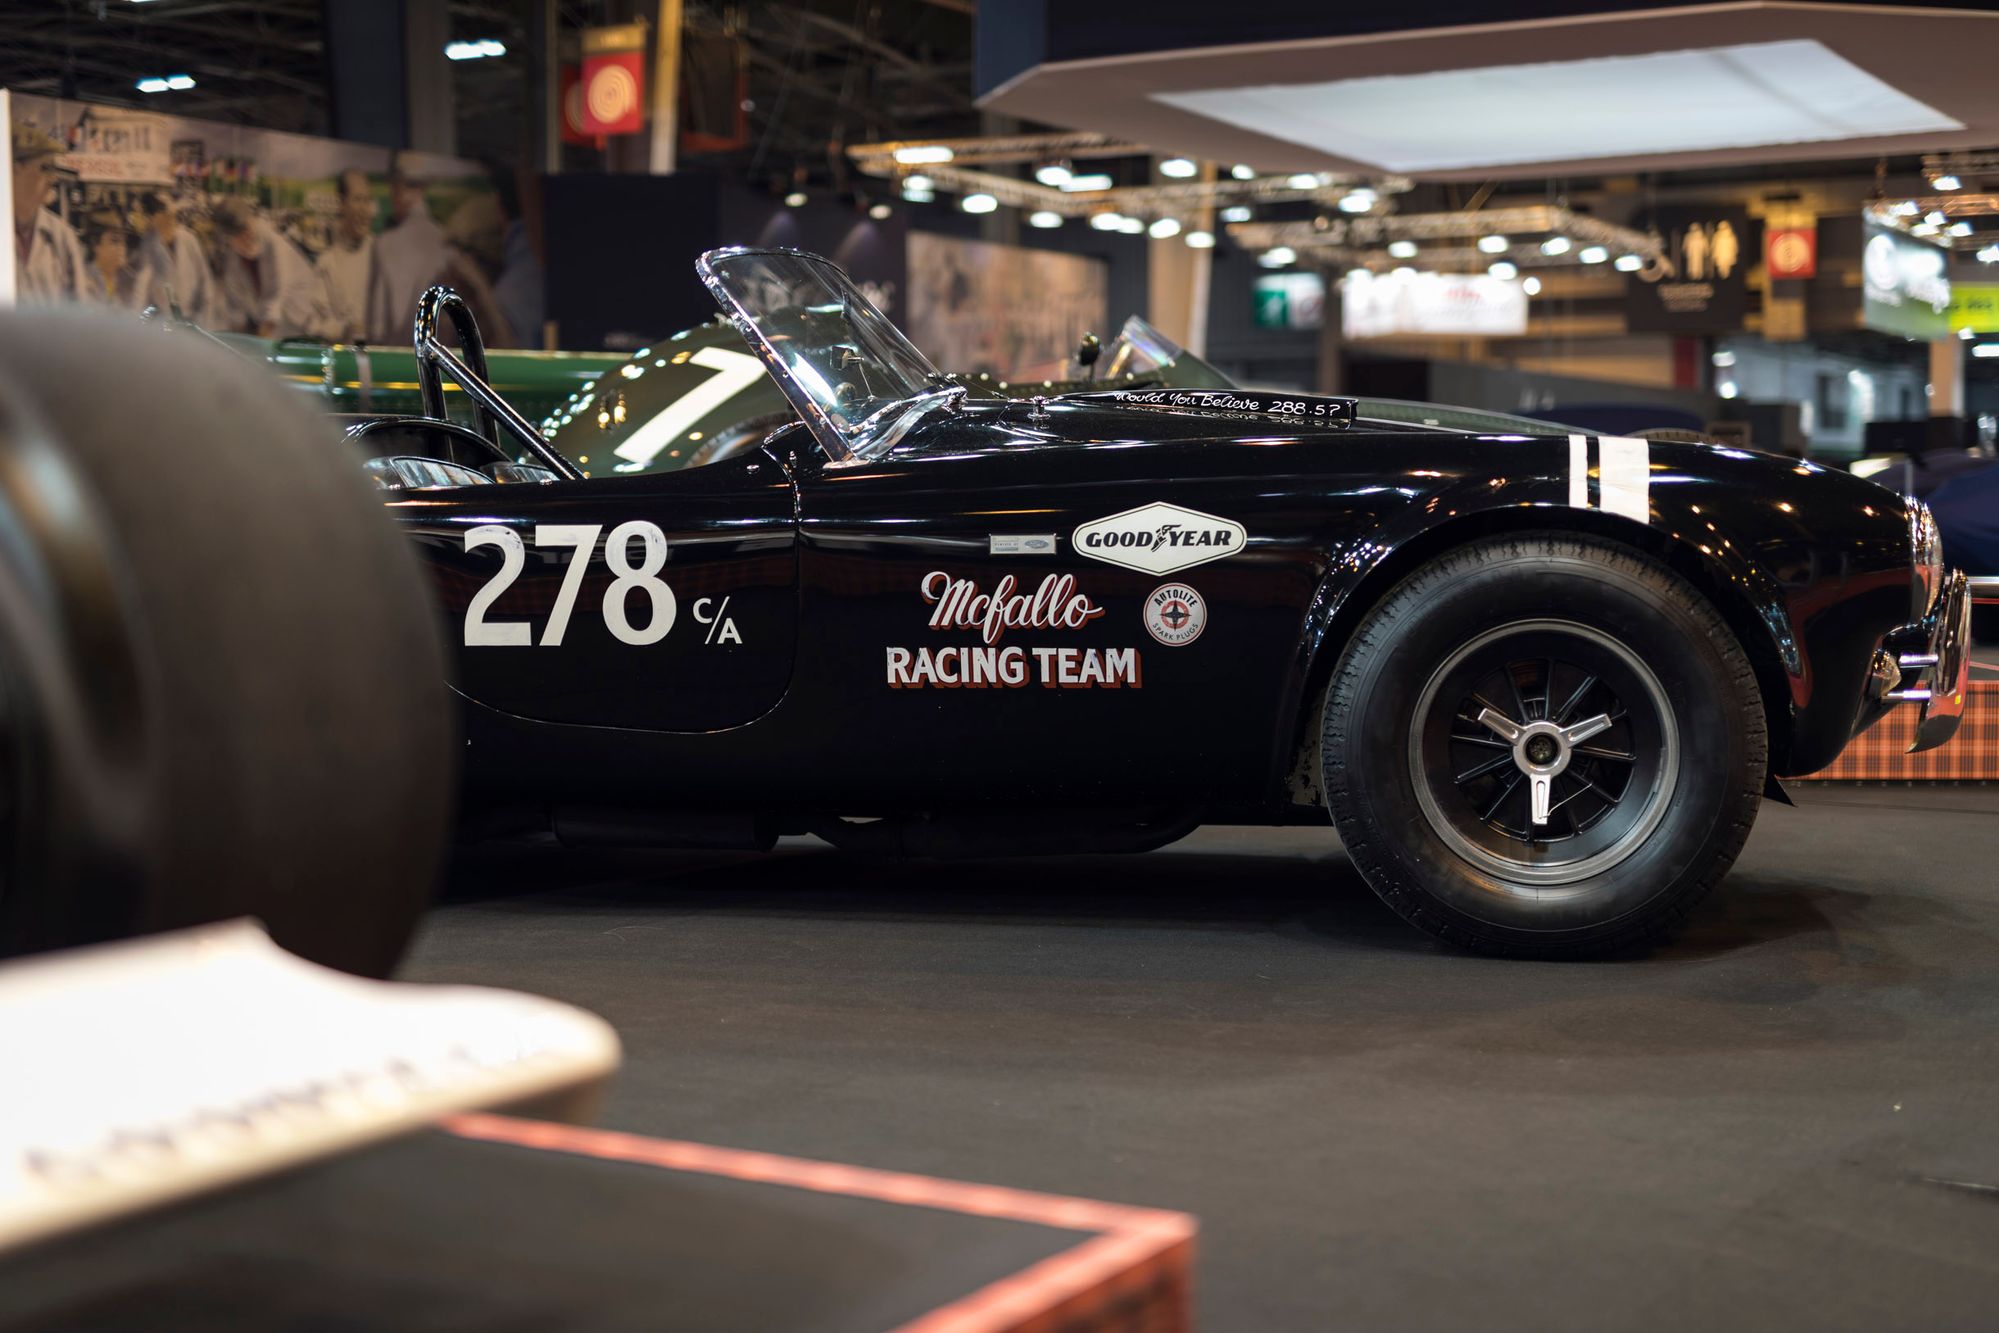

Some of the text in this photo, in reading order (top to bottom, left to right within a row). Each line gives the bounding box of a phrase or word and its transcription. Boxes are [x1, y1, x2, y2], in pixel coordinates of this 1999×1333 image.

[613, 346, 768, 464] 7
[1114, 391, 1166, 403] Would
[1169, 392, 1198, 407] You
[1200, 393, 1260, 411] Believe
[463, 520, 677, 647] 278
[1153, 588, 1198, 607] AUTOLITE
[1152, 622, 1199, 640] SPARK PLUGS
[885, 646, 1140, 687] RACING TEAM
